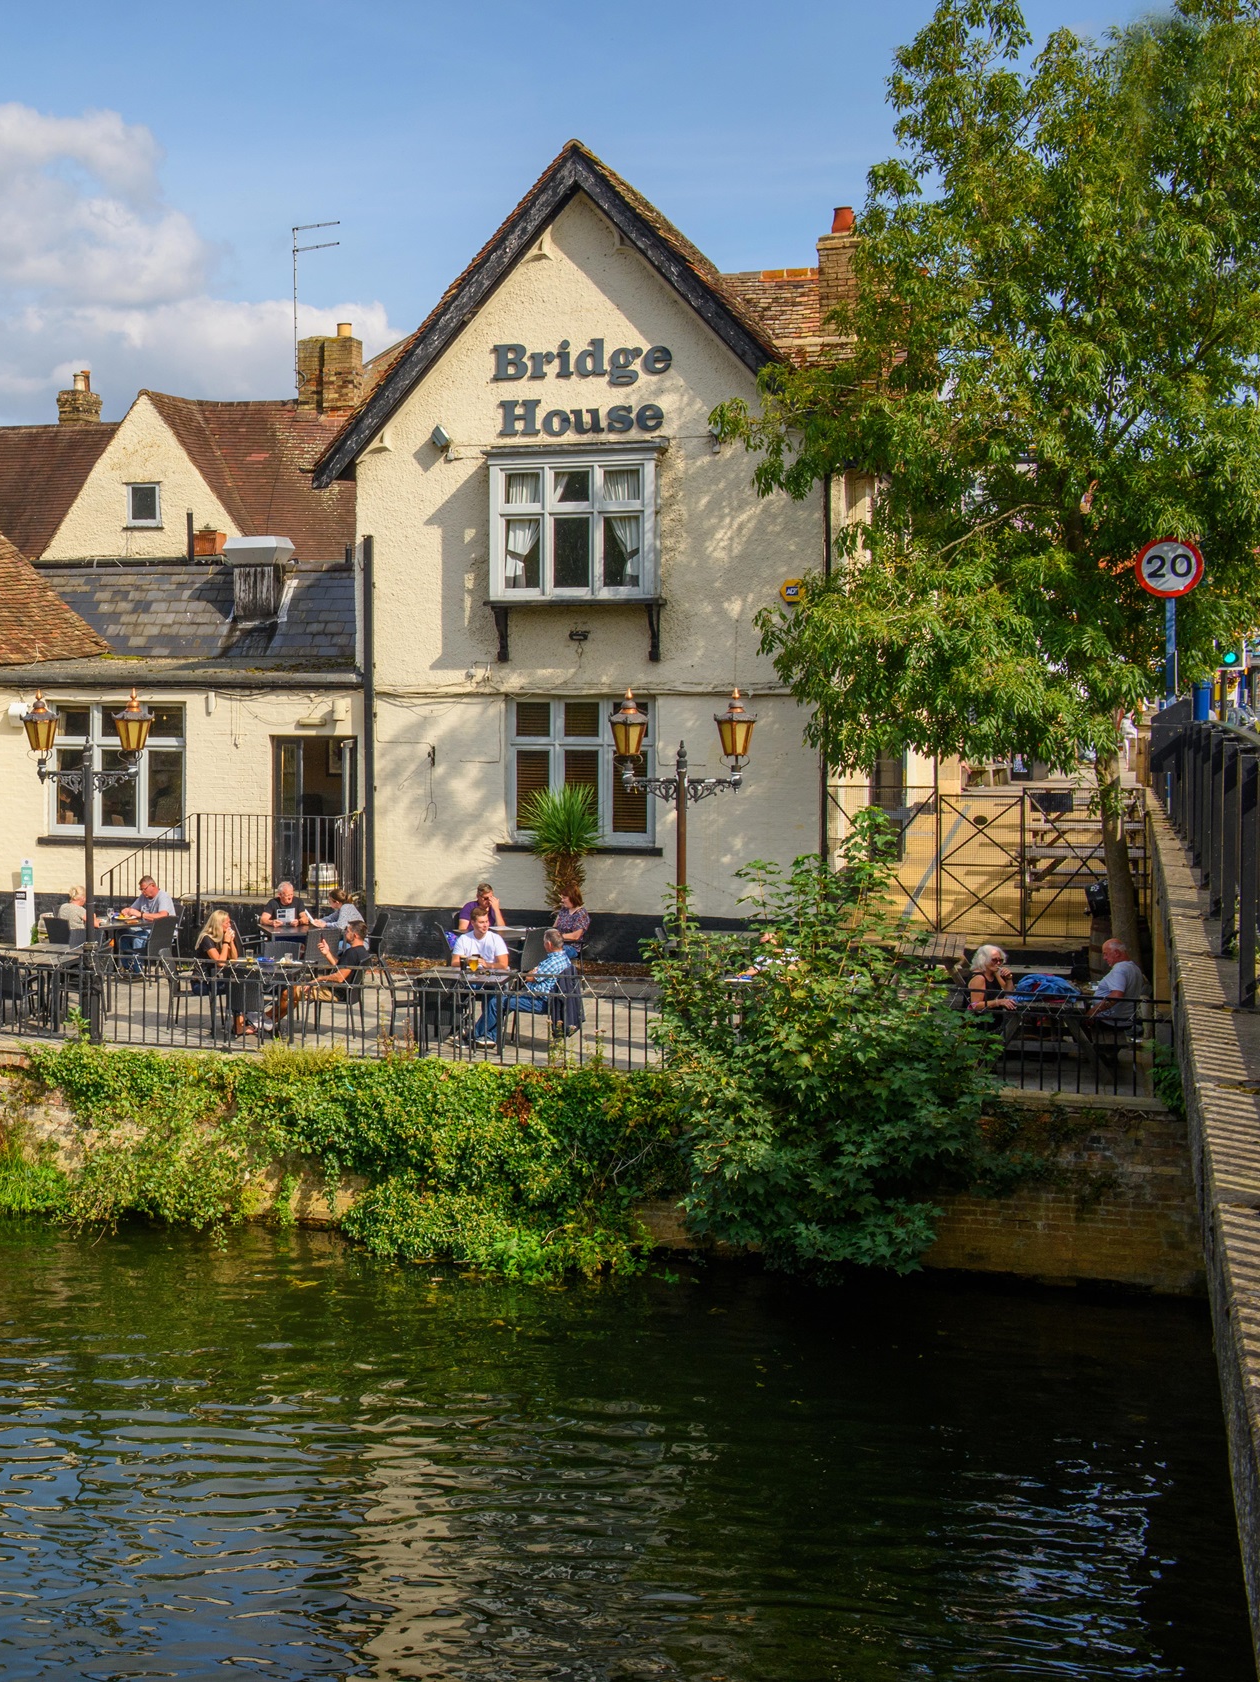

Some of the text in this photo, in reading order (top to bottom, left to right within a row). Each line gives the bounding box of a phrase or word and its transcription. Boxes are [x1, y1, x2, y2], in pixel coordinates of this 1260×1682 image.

[493, 338, 672, 385] Bridge
[499, 399, 664, 436] House
[1146, 554, 1192, 578] 20
